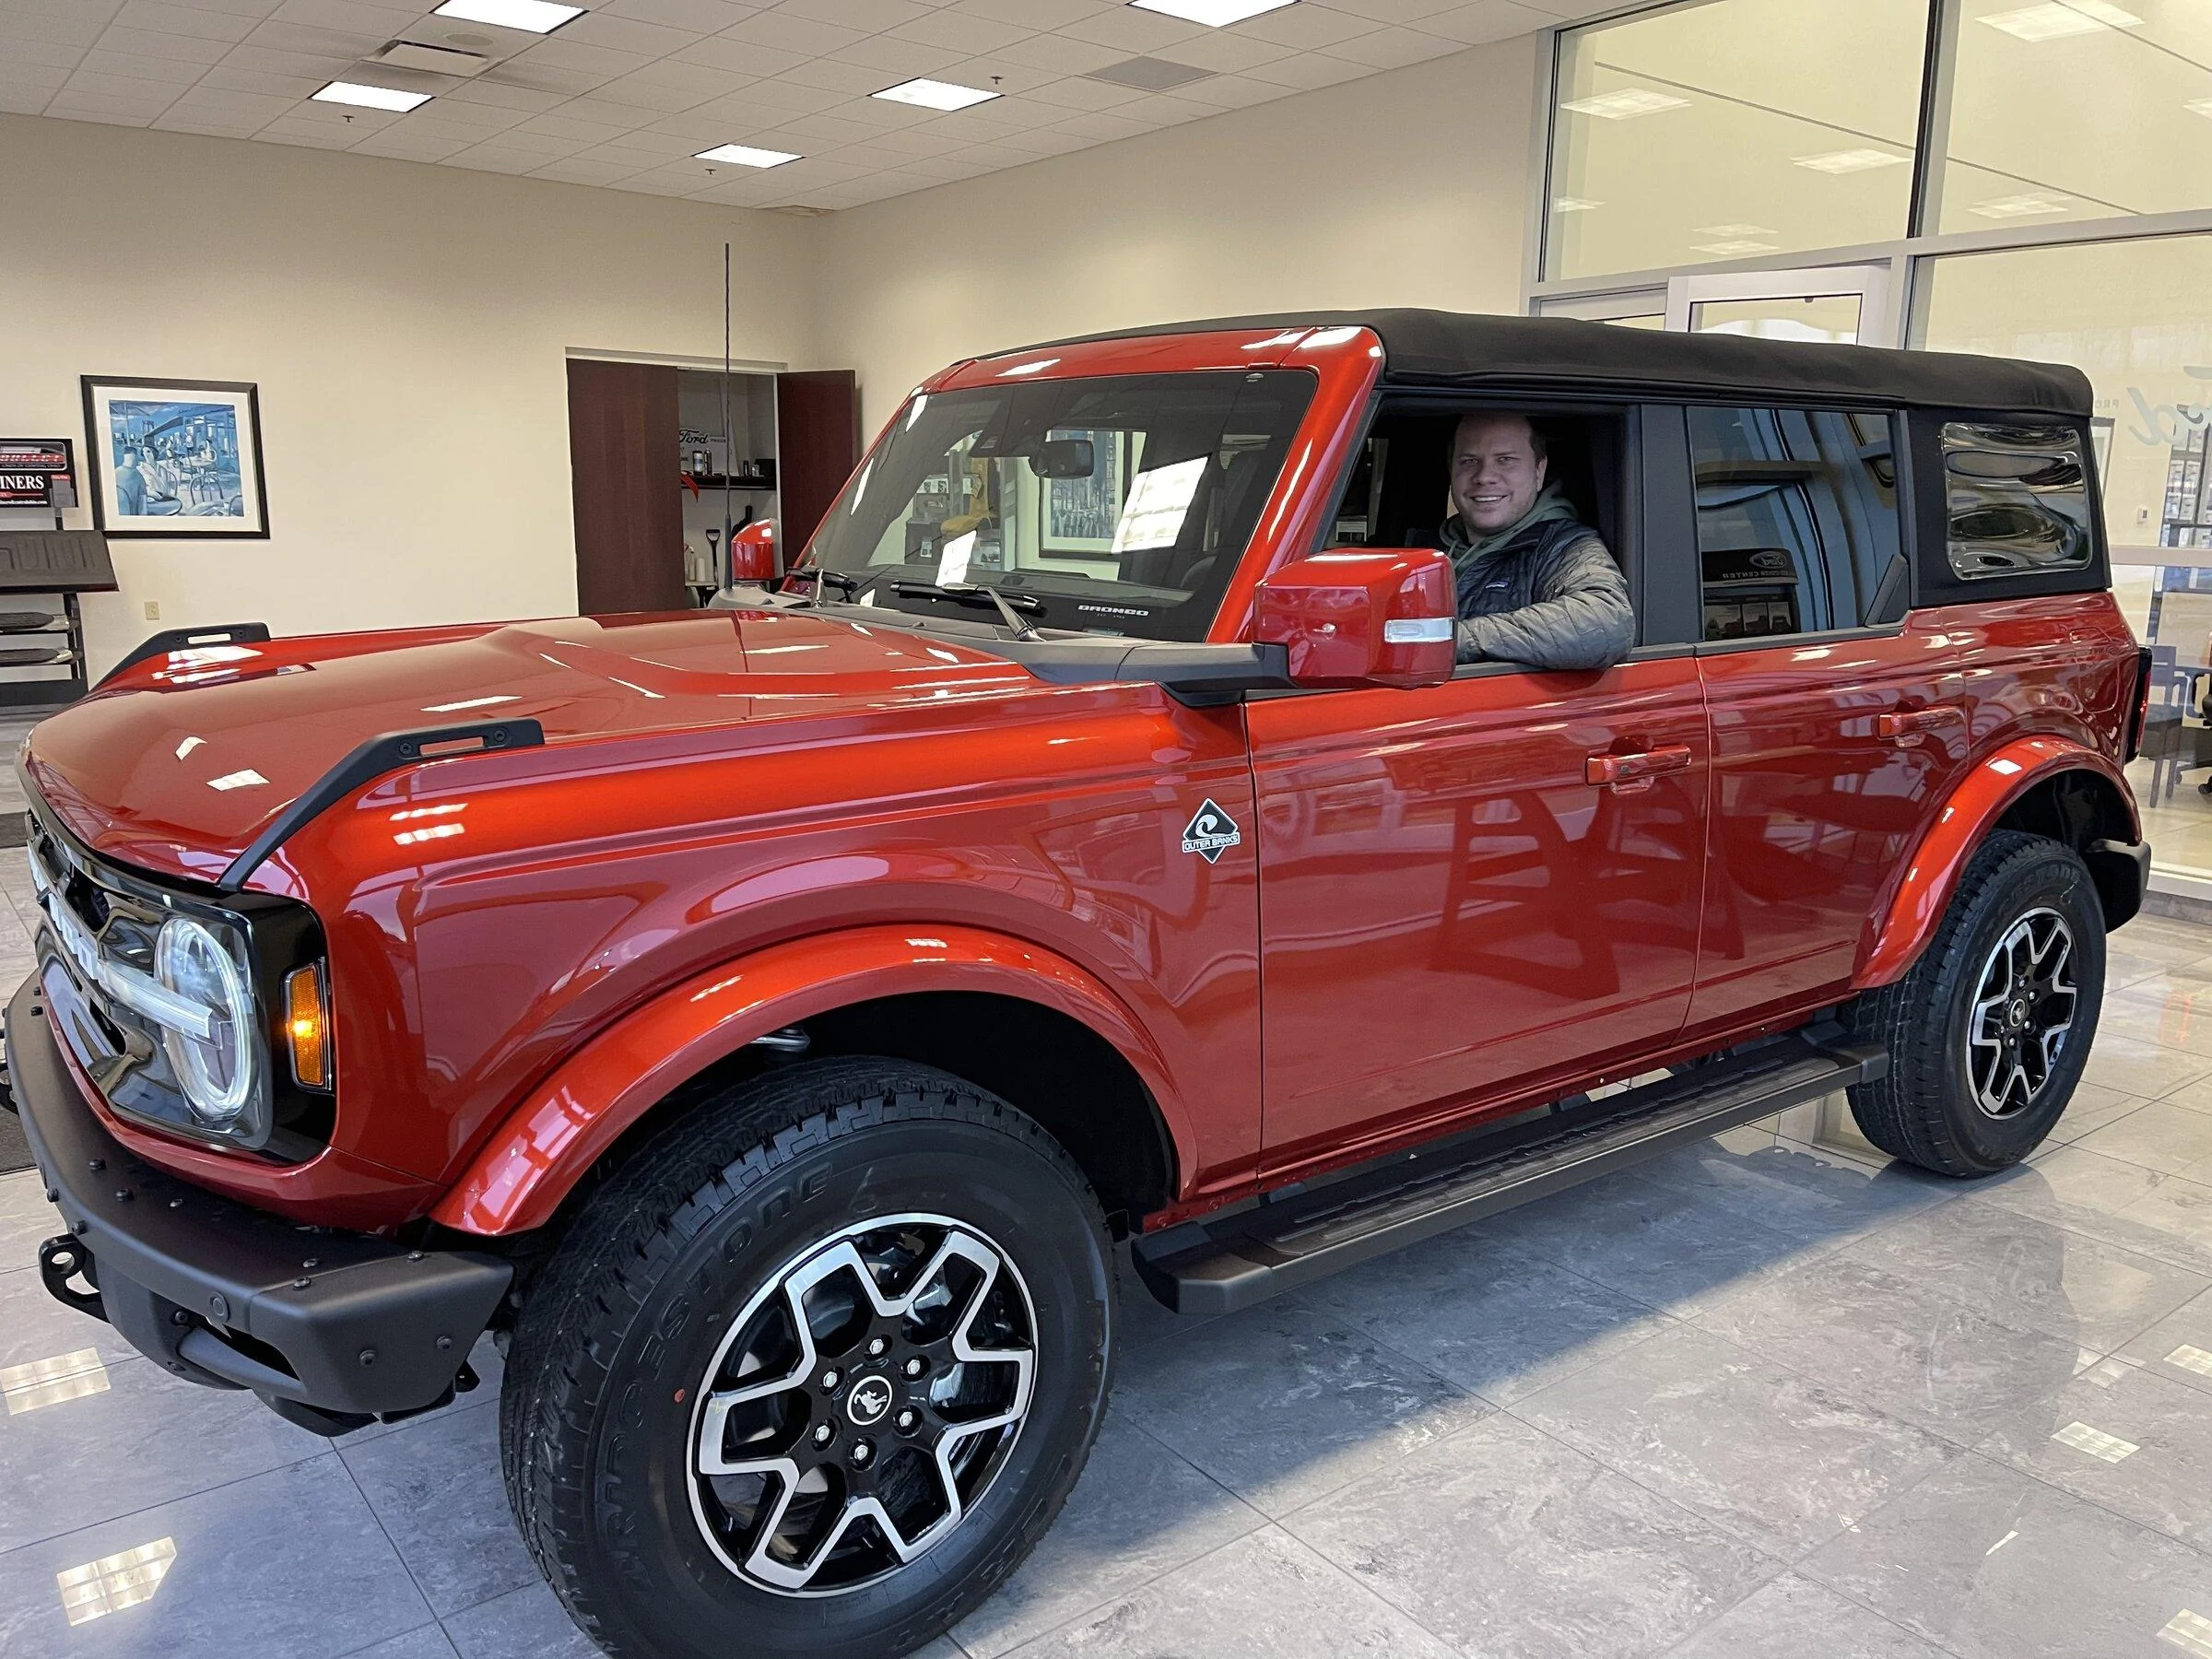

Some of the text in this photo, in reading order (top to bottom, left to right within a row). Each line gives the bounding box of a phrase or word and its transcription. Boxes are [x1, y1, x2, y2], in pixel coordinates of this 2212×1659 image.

[679, 429, 708, 443] Ford
[1077, 605, 1149, 617] BRONCO
[1184, 835, 1238, 851] OUTER BANKS
